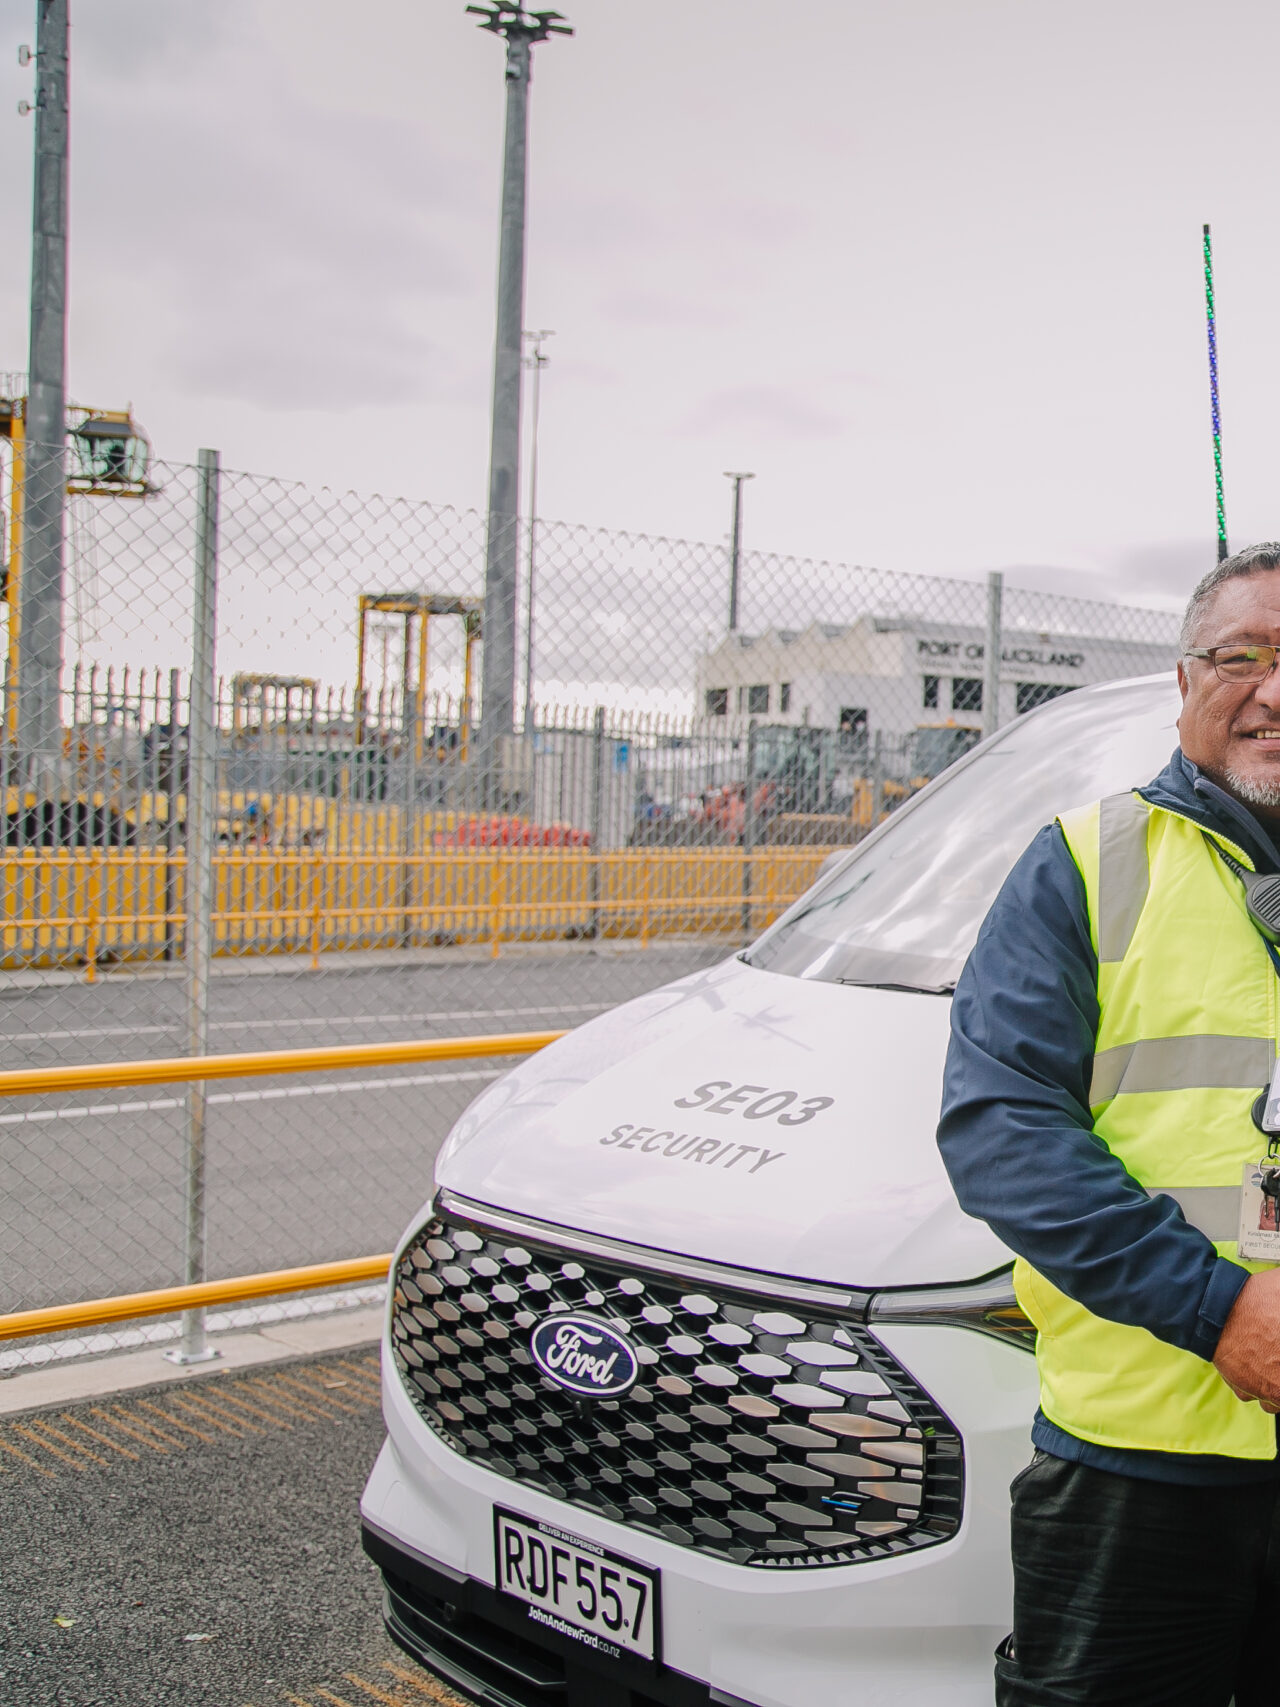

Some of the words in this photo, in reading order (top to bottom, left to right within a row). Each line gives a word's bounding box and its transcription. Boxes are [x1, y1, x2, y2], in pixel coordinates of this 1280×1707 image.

[917, 640, 959, 657] PORT
[1001, 648, 1086, 668] UCKLAND
[599, 1124, 786, 1174] SECURITY
[546, 1325, 619, 1385] Ford
[538, 1523, 561, 1540] DELIVER
[561, 1533, 570, 1543] AN
[569, 1535, 605, 1557] EXPERIENCE
[504, 1525, 648, 1641] RDF557
[528, 1606, 621, 1658] JohnAndrewFord.co.nz
